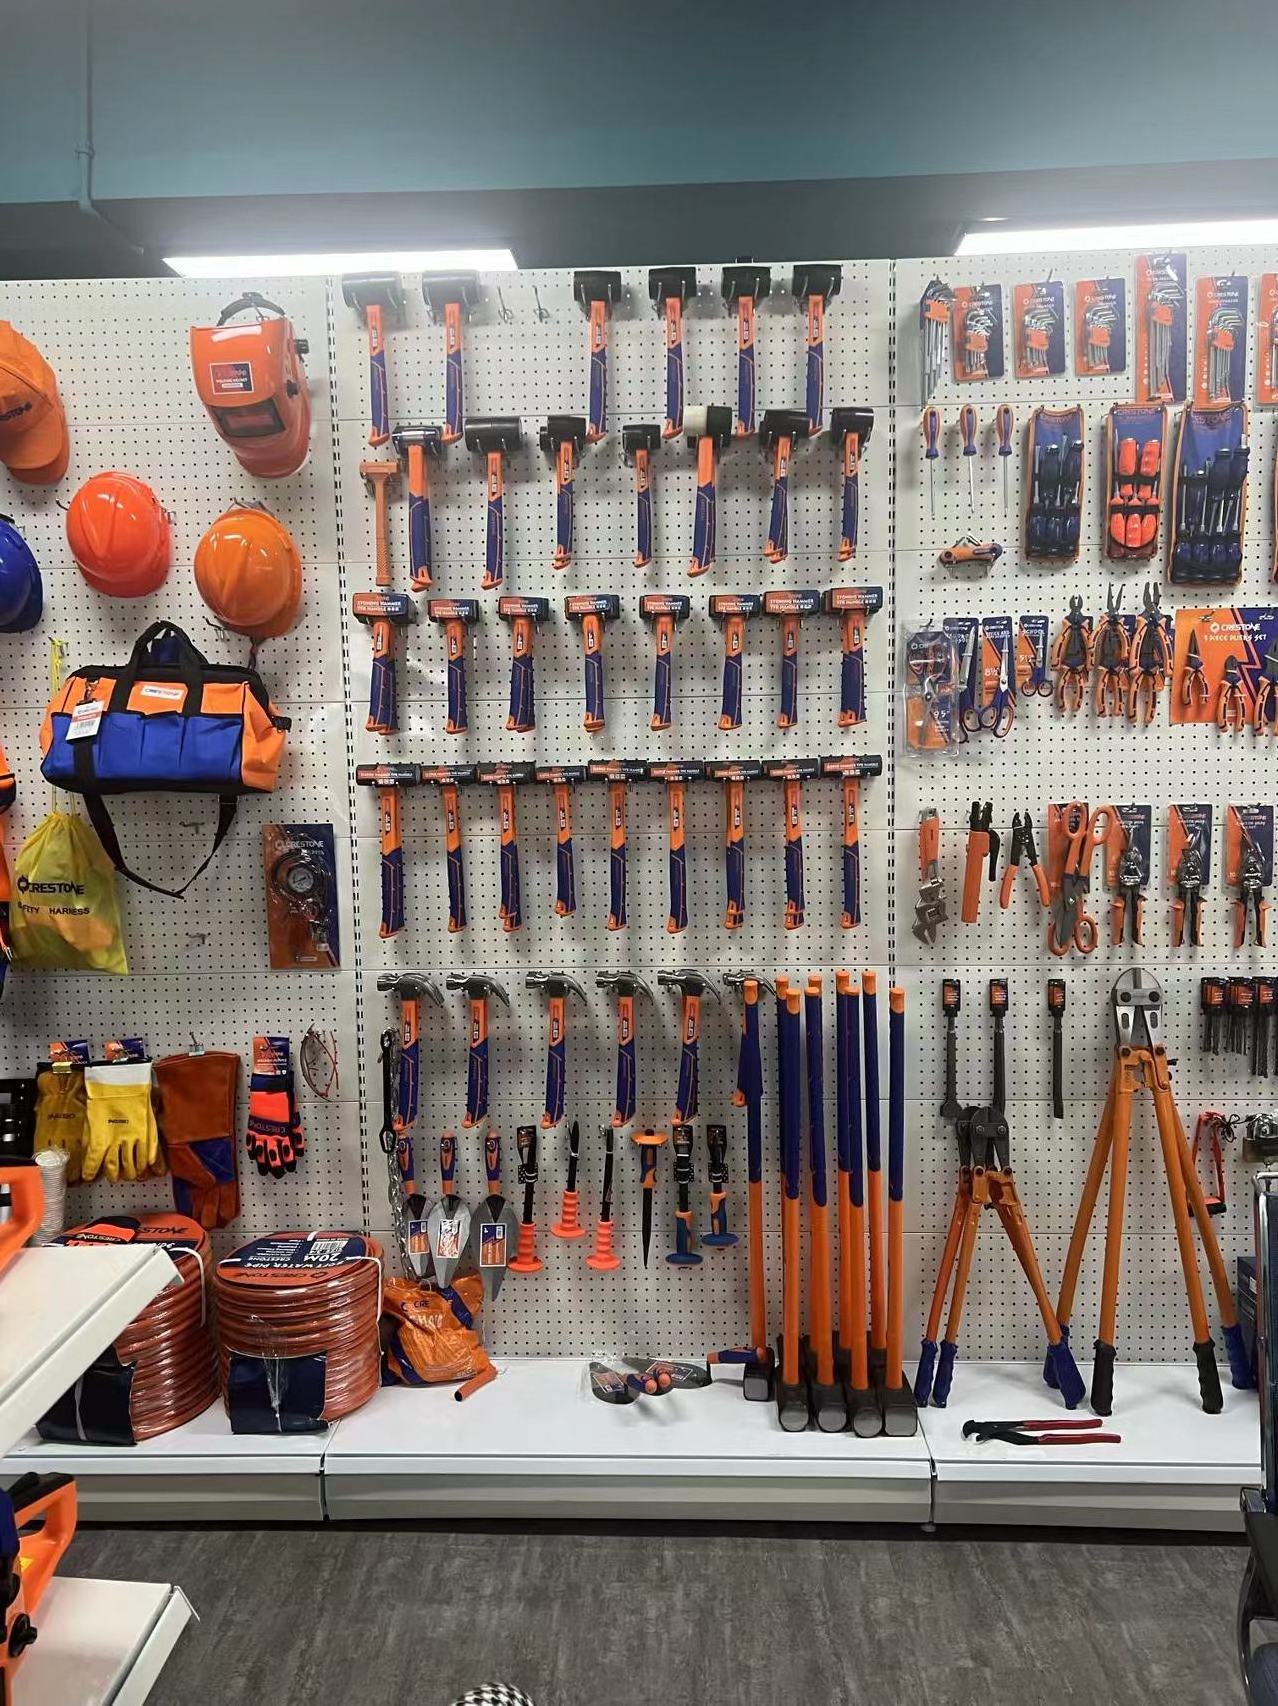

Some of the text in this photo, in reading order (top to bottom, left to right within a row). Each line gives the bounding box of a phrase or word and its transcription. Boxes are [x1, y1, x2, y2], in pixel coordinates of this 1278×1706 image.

[1220, 623, 1261, 632] CRESTONE
[1254, 634, 1267, 642] SET
[286, 840, 324, 848] CRESTONE
[49, 907, 90, 916] HARNESS
[304, 1252, 341, 1262] 20M
